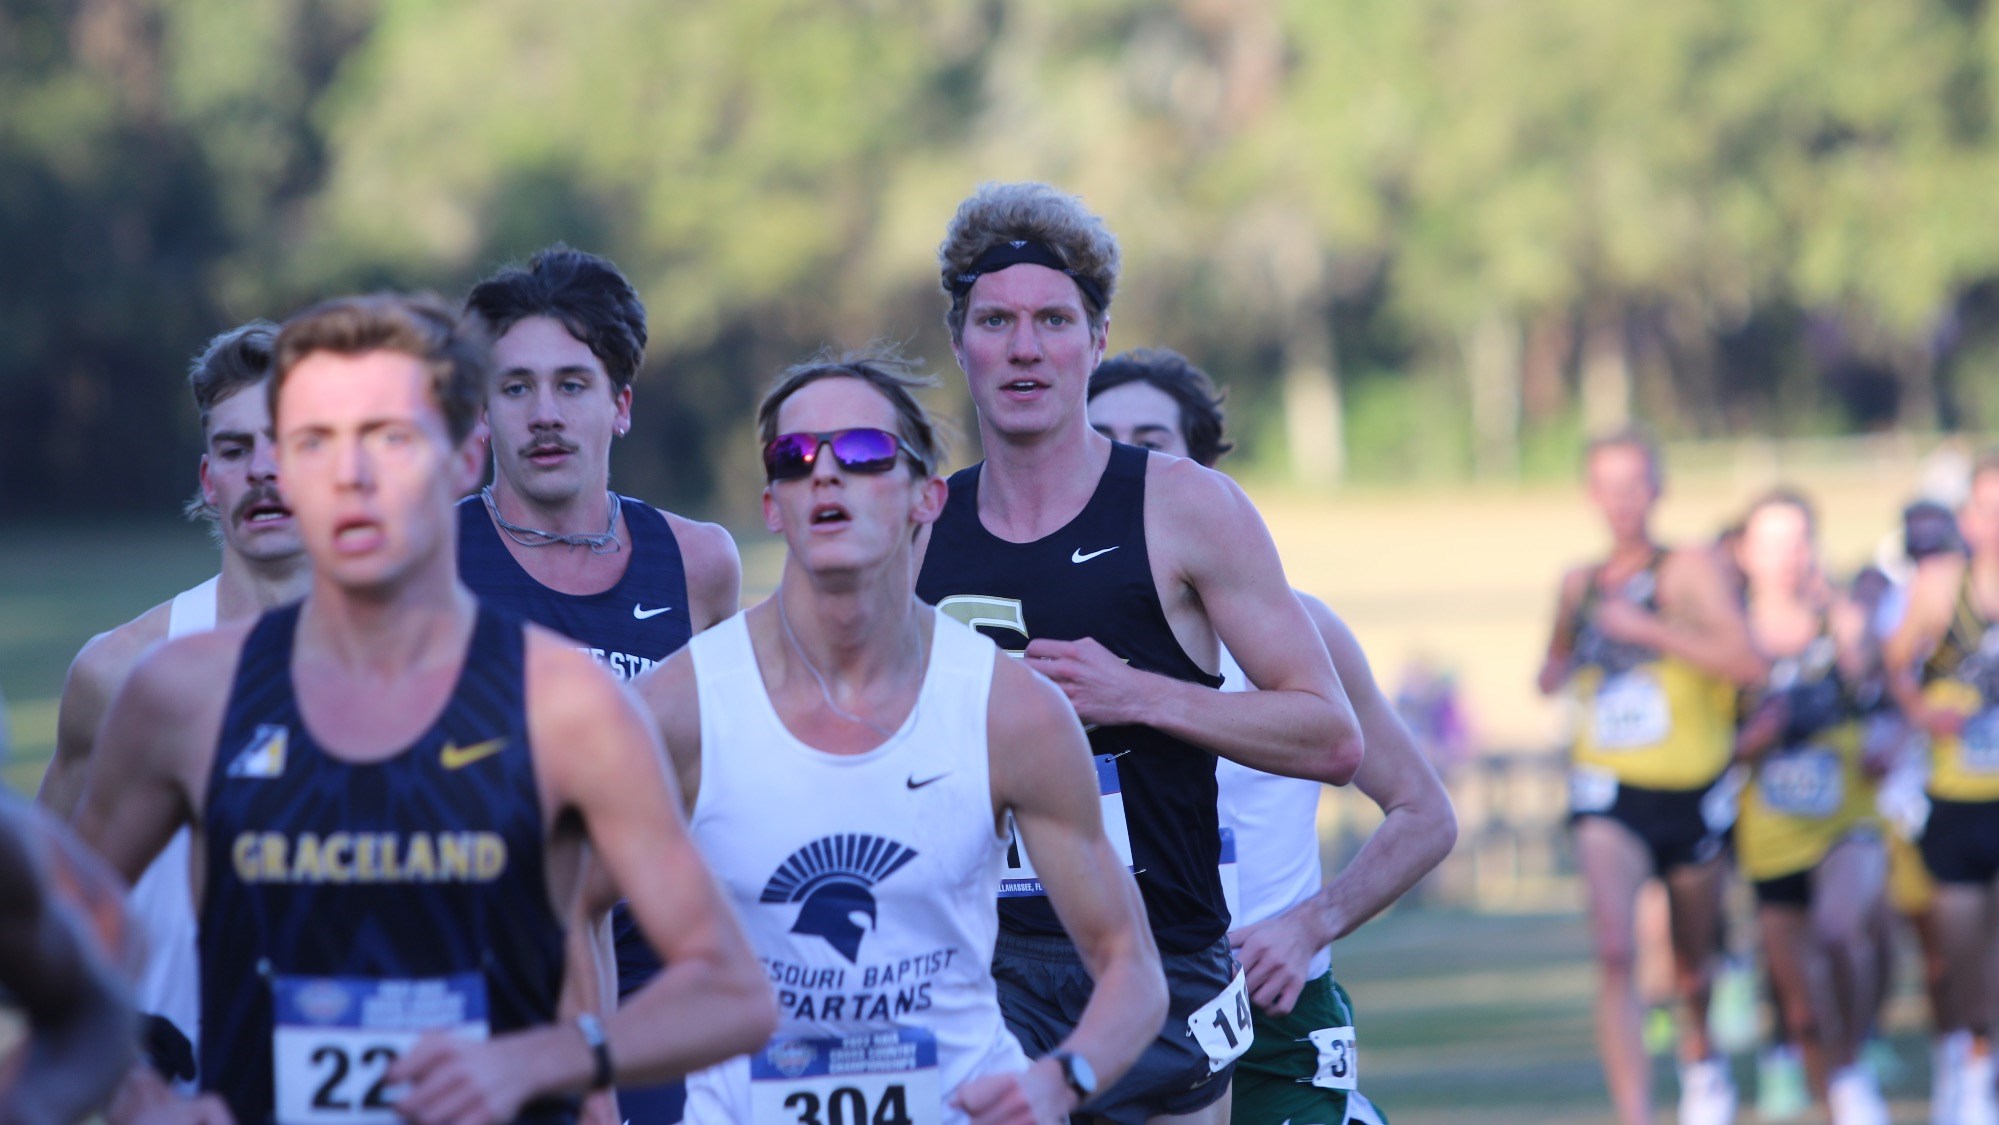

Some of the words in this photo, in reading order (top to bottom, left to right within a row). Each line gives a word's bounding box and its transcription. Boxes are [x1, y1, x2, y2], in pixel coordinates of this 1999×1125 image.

[233, 832, 507, 883] GRACELAND
[863, 949, 958, 988] BAPTIST
[784, 1084, 914, 1125] 304
